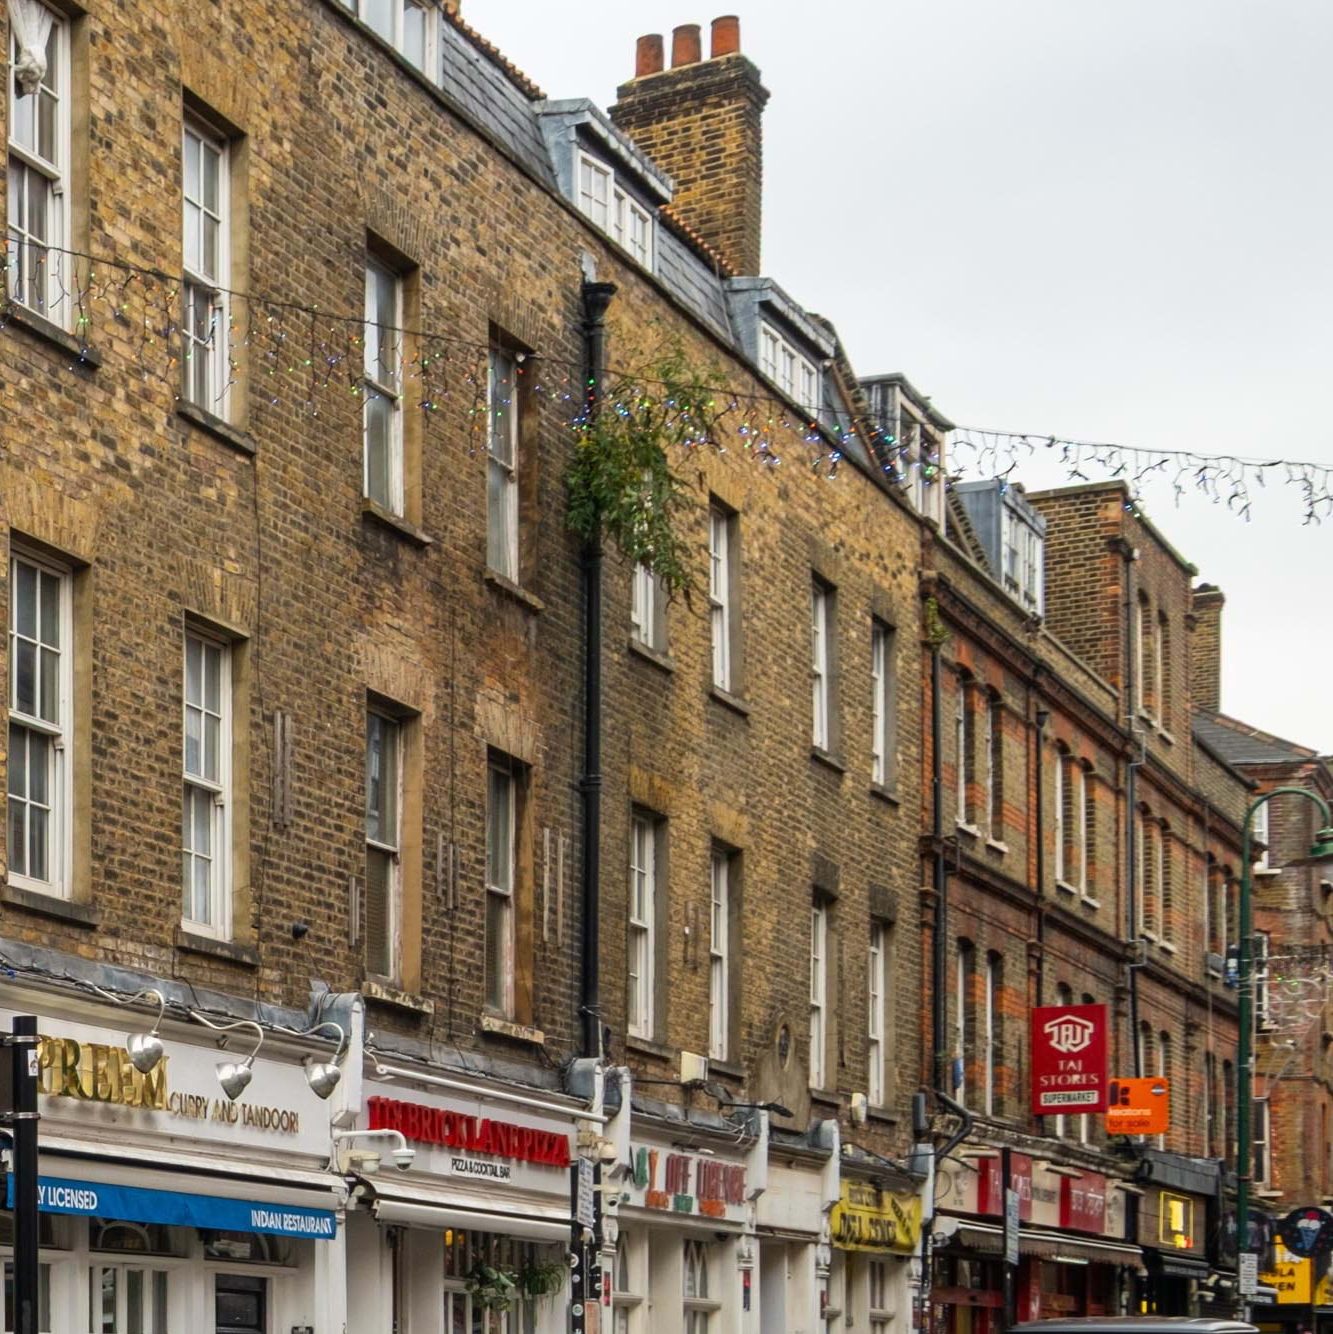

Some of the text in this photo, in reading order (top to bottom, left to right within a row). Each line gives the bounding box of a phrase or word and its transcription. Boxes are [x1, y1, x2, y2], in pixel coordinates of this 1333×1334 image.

[1058, 1060, 1082, 1071] TAJ
[1040, 1073, 1099, 1087] STORES
[1043, 1091, 1096, 1105] SUPERMARKET
[170, 1090, 299, 1134] CURRY AND TANDOORI
[405, 1102, 476, 1151] BRICK
[475, 1117, 520, 1159] LANE
[520, 1127, 571, 1168] PIZZA
[451, 1157, 511, 1179] PIZZA & COCKTAIL BAR
[48, 1187, 98, 1210] LICENSED
[251, 1209, 282, 1230] INDIAN
[283, 1213, 331, 1234] RESTAURANT
